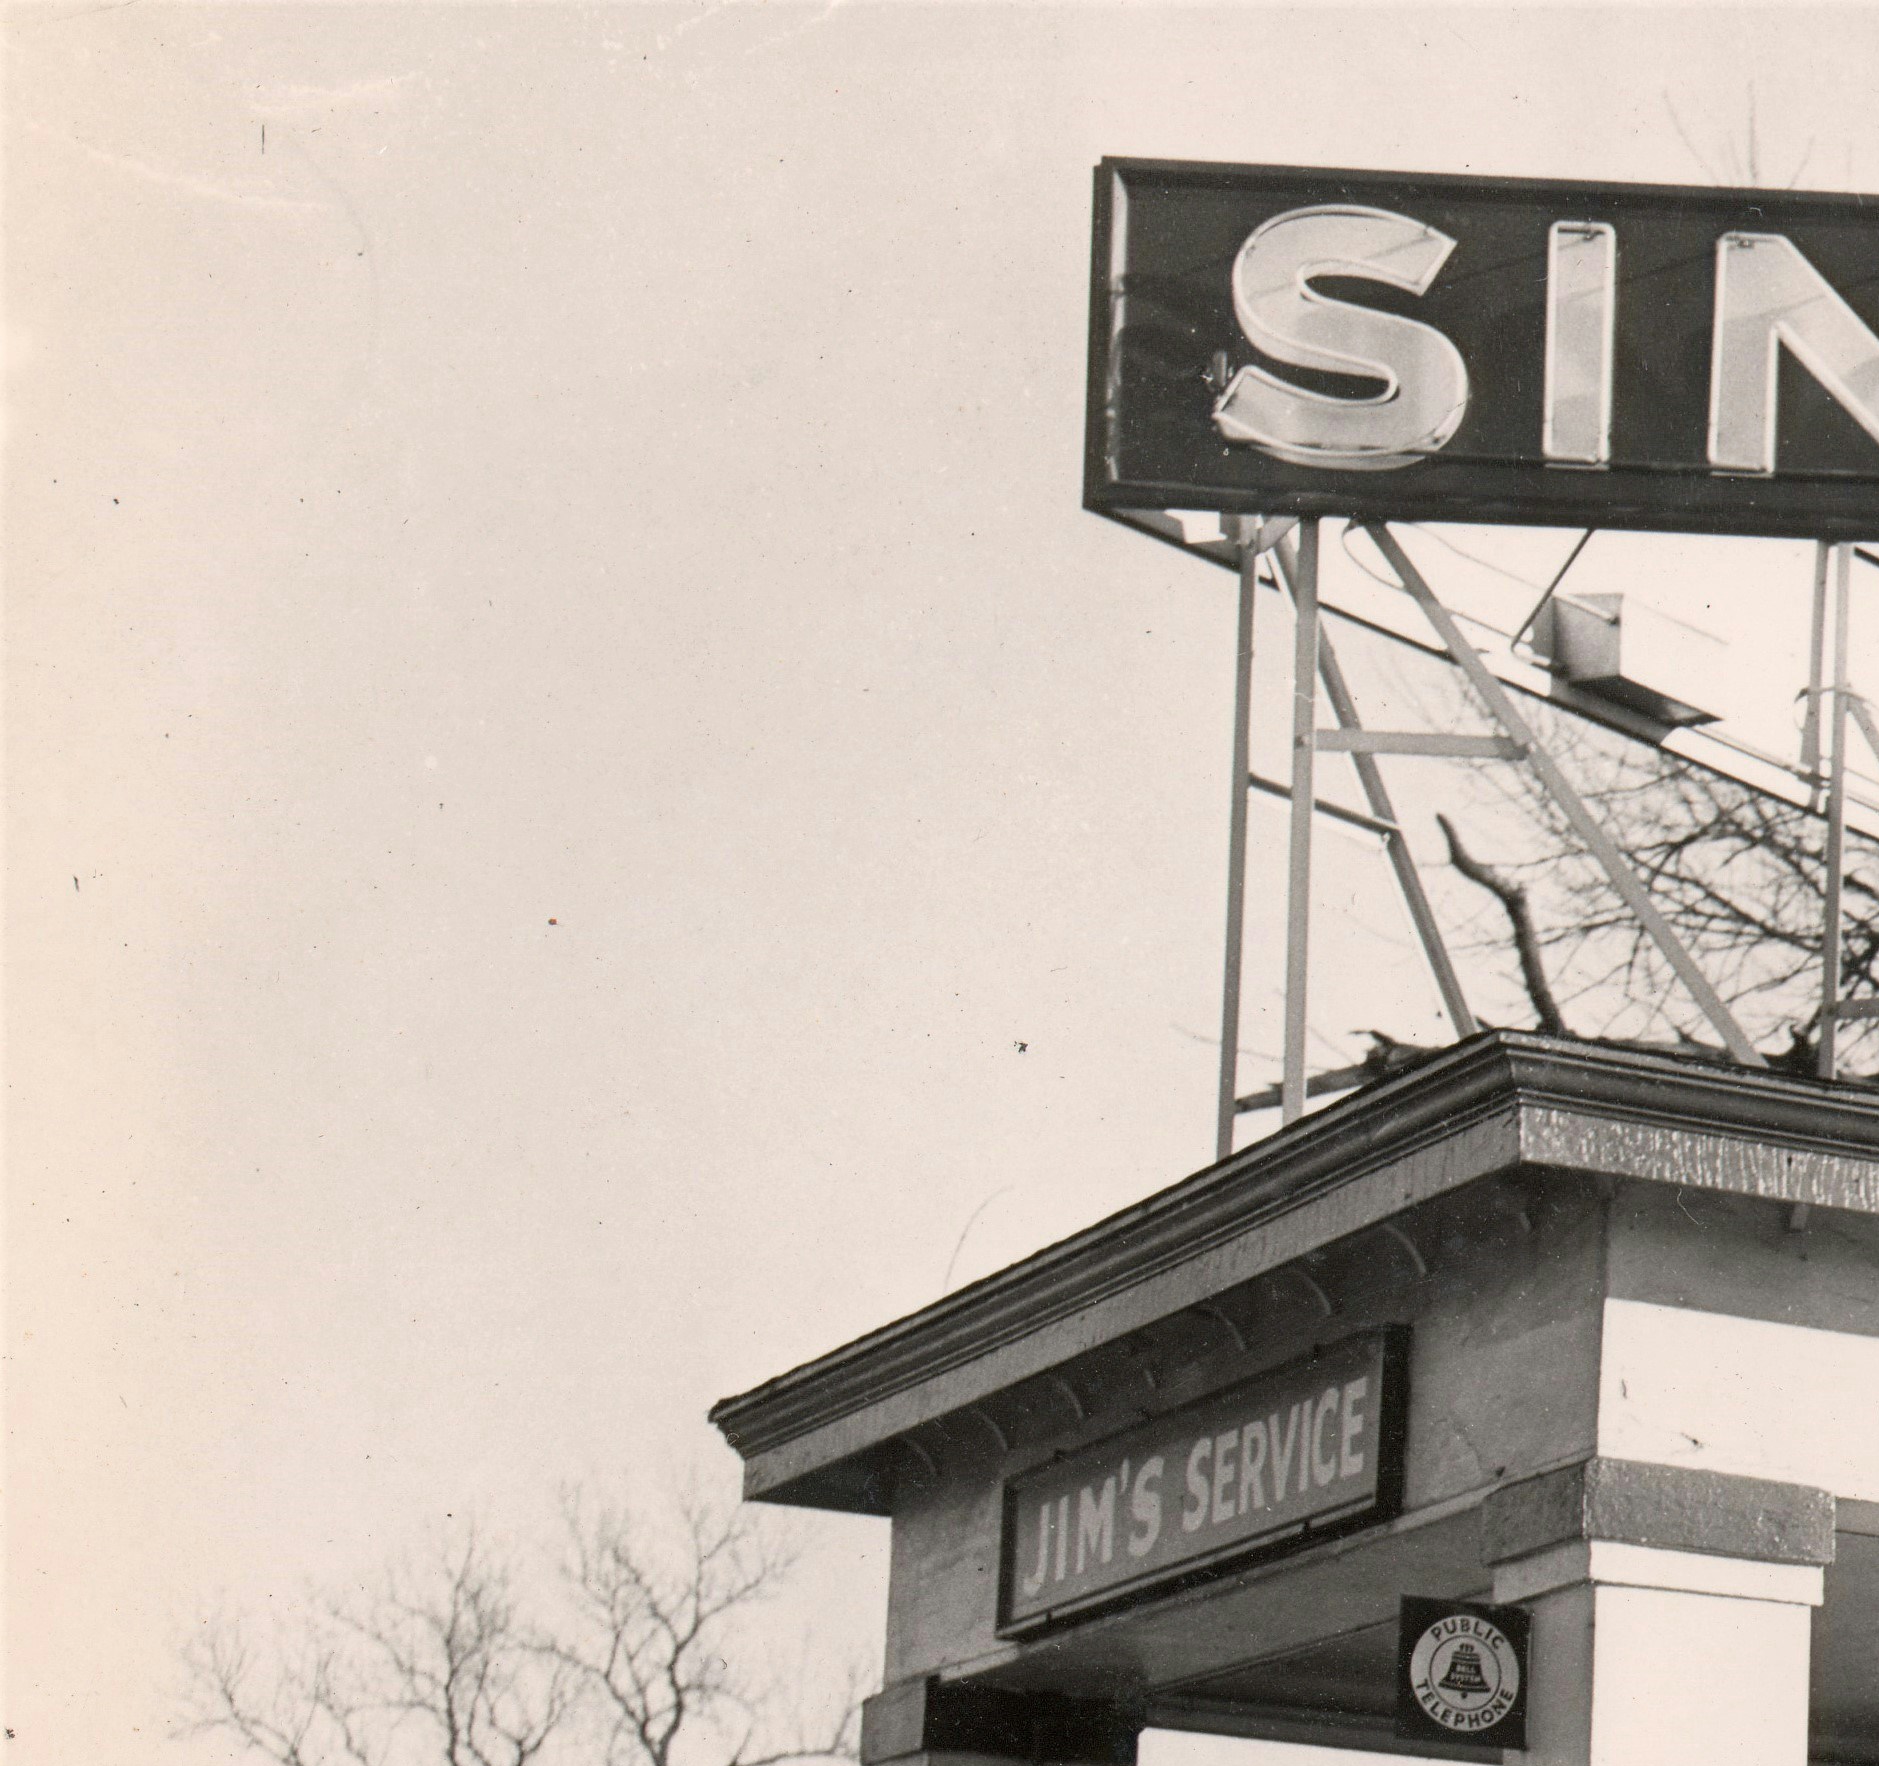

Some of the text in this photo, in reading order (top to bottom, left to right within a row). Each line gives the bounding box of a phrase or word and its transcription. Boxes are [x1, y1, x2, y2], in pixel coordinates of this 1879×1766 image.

[1023, 1377, 1367, 1597] JIM'S SERVICE
[1430, 1618, 1504, 1650] PUBLIC
[1416, 1678, 1514, 1728] TELEPHONE
